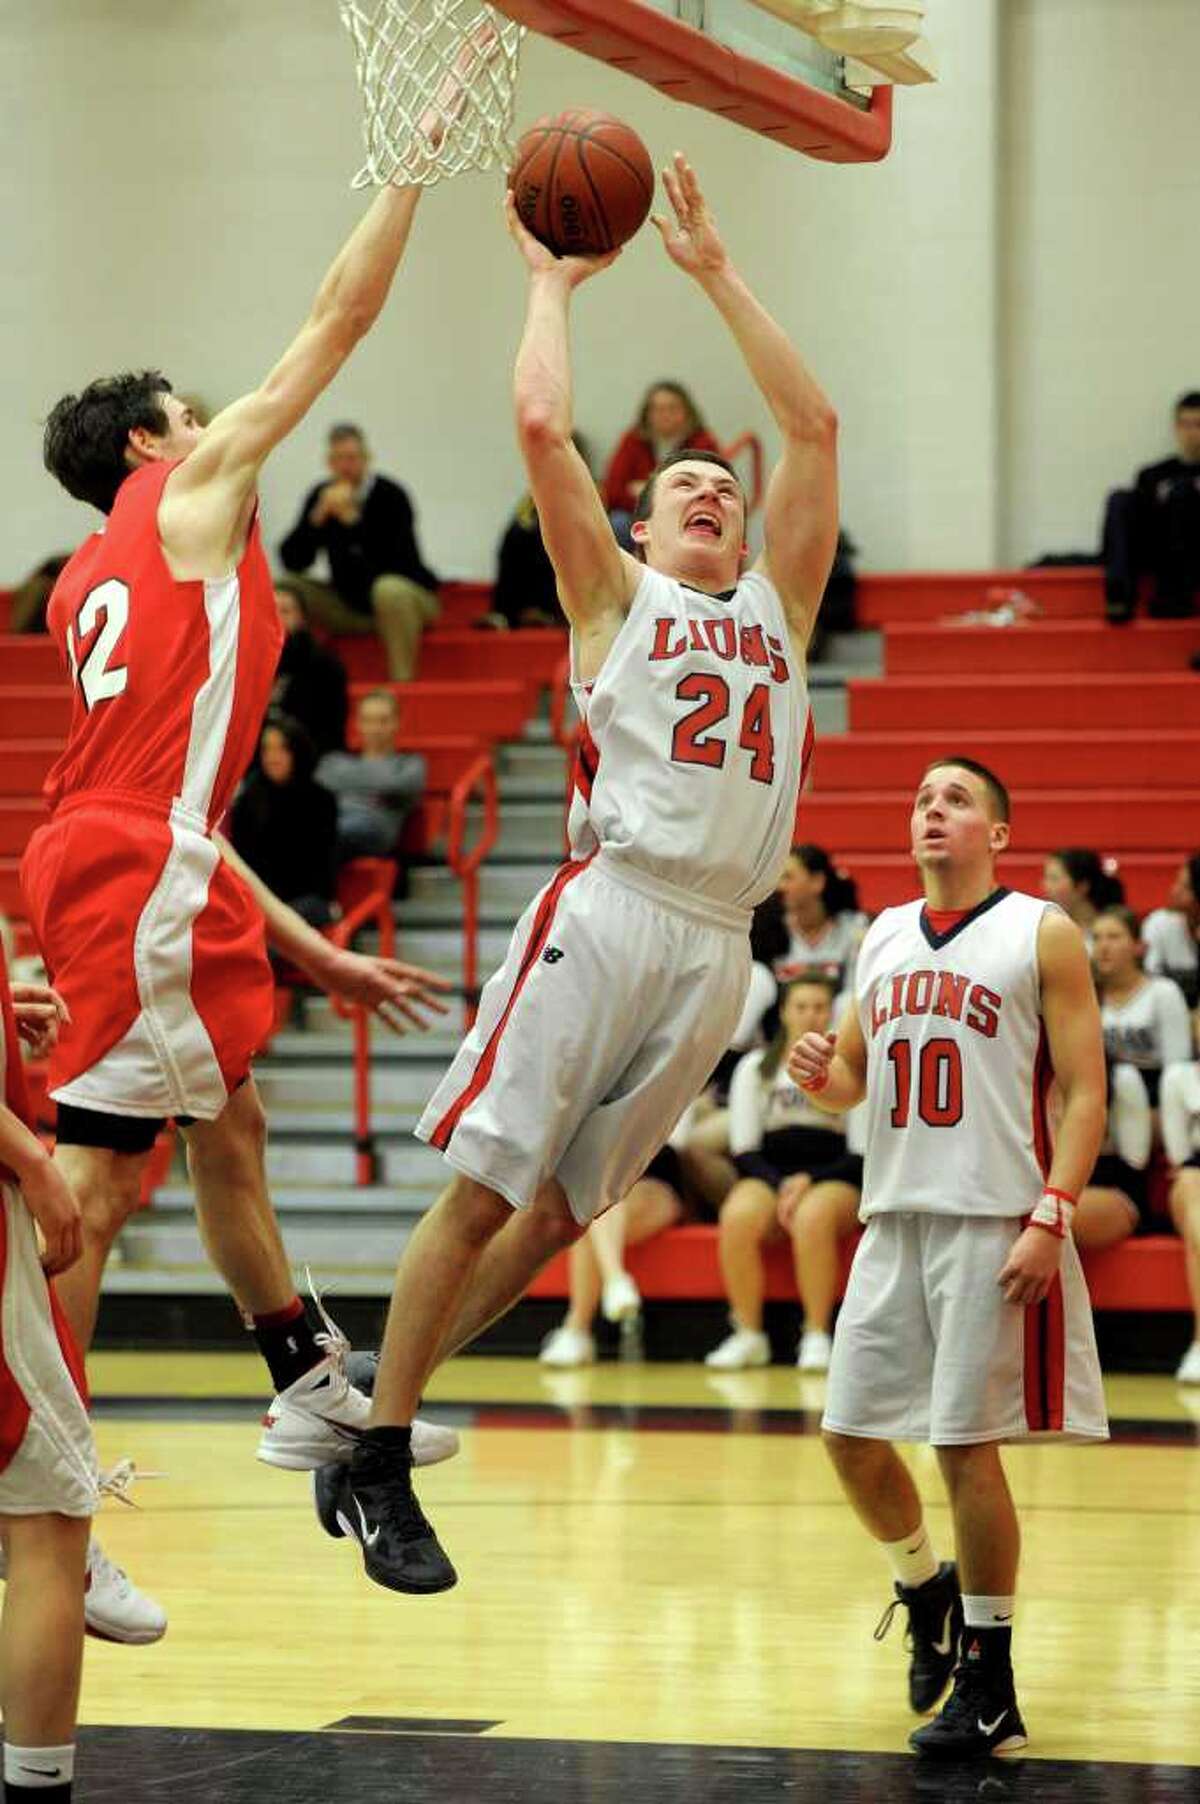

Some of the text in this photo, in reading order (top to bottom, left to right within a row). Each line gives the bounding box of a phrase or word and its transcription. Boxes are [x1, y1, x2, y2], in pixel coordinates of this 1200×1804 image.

[66, 576, 130, 713] 2
[671, 672, 774, 785] 24
[871, 970, 1002, 1039] LIONS
[887, 1038, 963, 1128] 10
